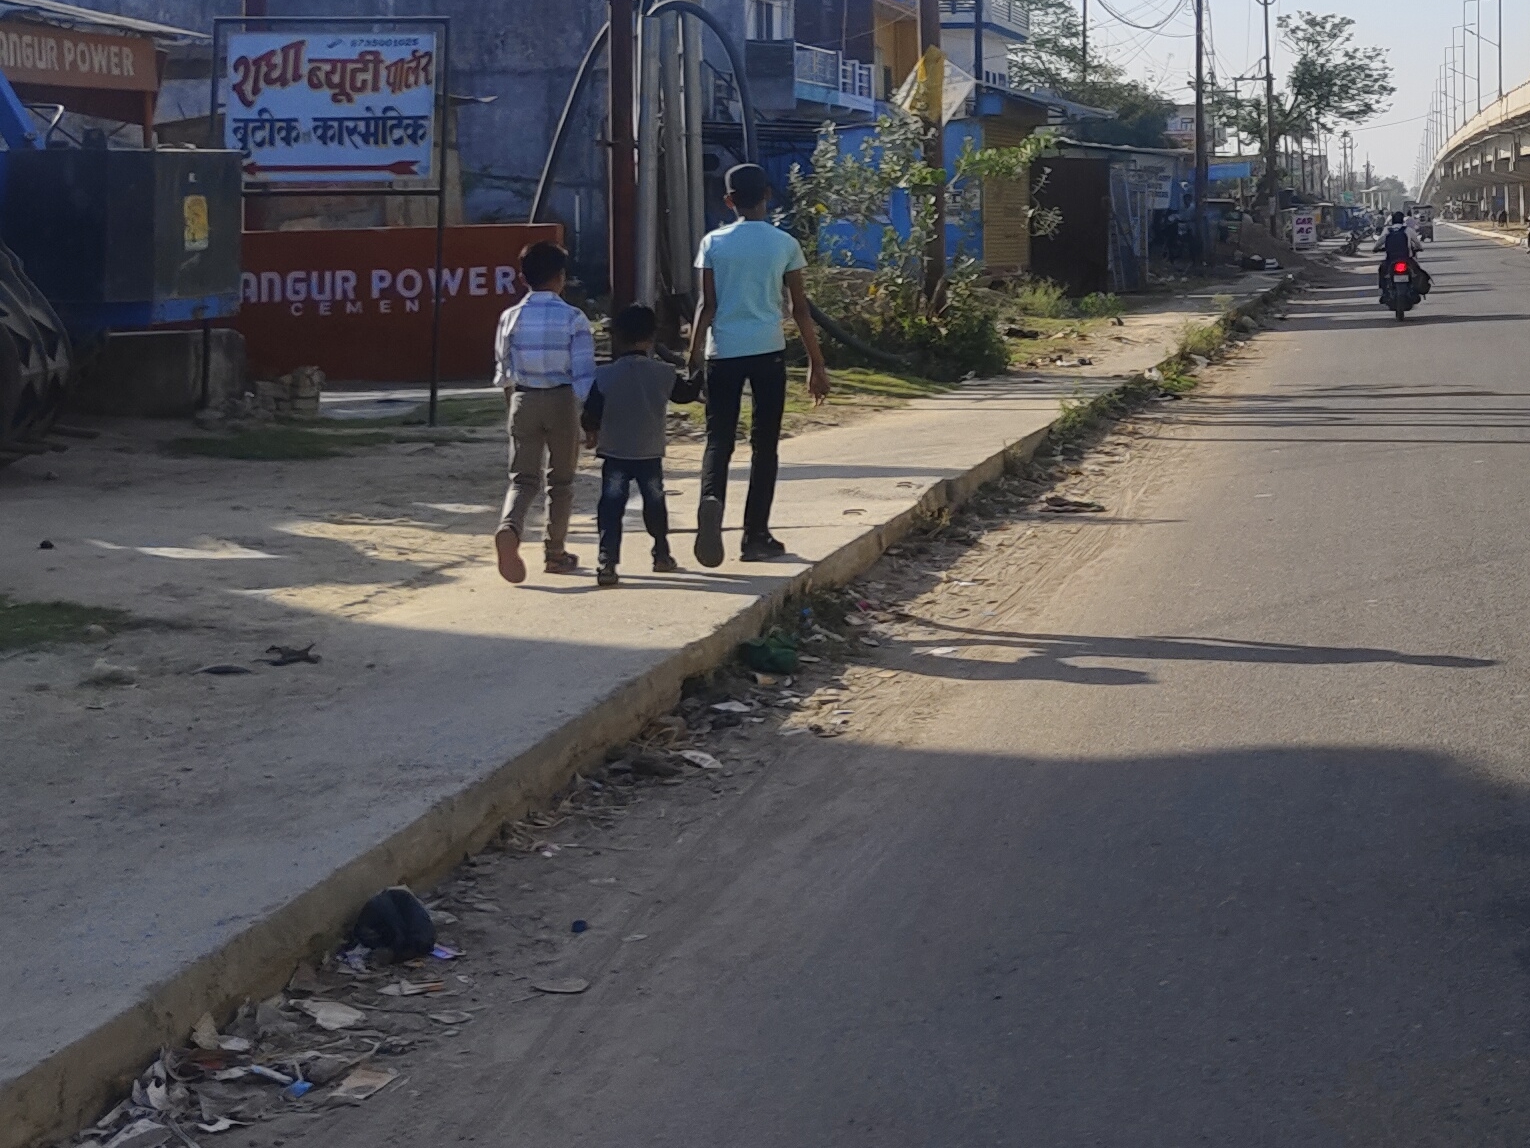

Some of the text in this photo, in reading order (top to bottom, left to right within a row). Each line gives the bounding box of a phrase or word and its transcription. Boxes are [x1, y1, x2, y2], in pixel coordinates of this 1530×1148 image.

[62, 39, 136, 77] POWER
[232, 39, 306, 107] राधा
[370, 265, 517, 299] POWER
